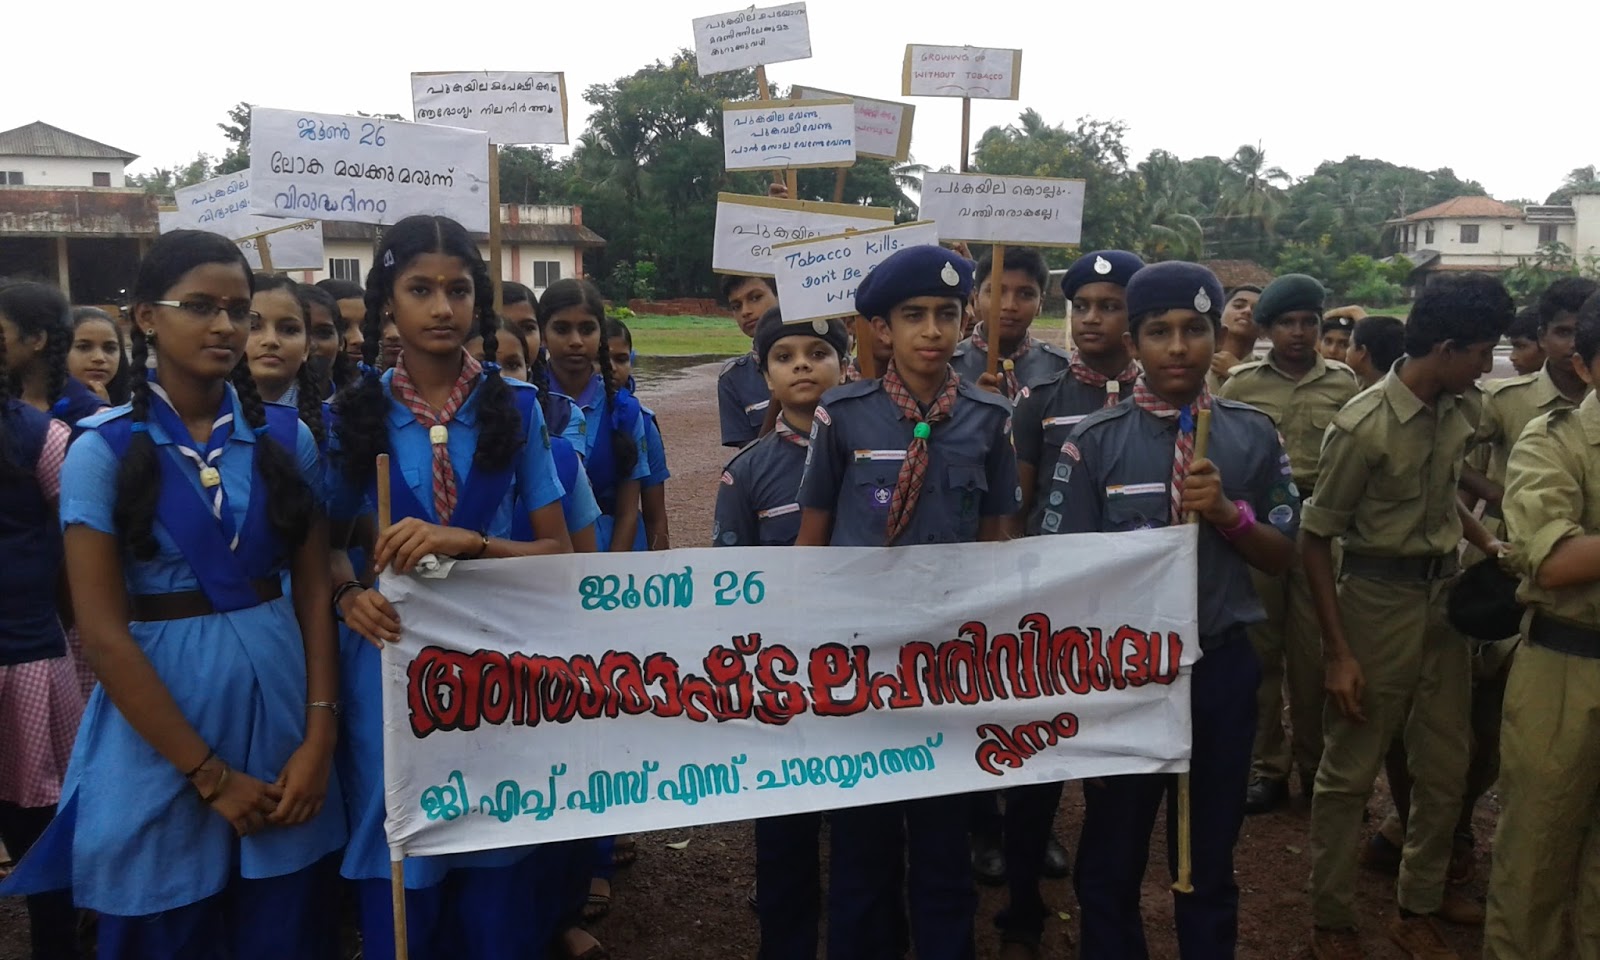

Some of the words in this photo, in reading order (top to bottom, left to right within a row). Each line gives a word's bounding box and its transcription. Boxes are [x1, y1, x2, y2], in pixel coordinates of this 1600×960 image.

[914, 71, 956, 79] WITHOUT
[965, 71, 1003, 80] TOBACCO
[297, 117, 351, 141] ജൂൺ
[359, 123, 386, 147] 26
[270, 150, 324, 175] ലോക
[935, 178, 1006, 195] പുകയില
[785, 247, 852, 269] Tobacco
[842, 267, 862, 281] Be
[578, 565, 694, 611] ജൂൺ
[713, 570, 765, 607] 26
